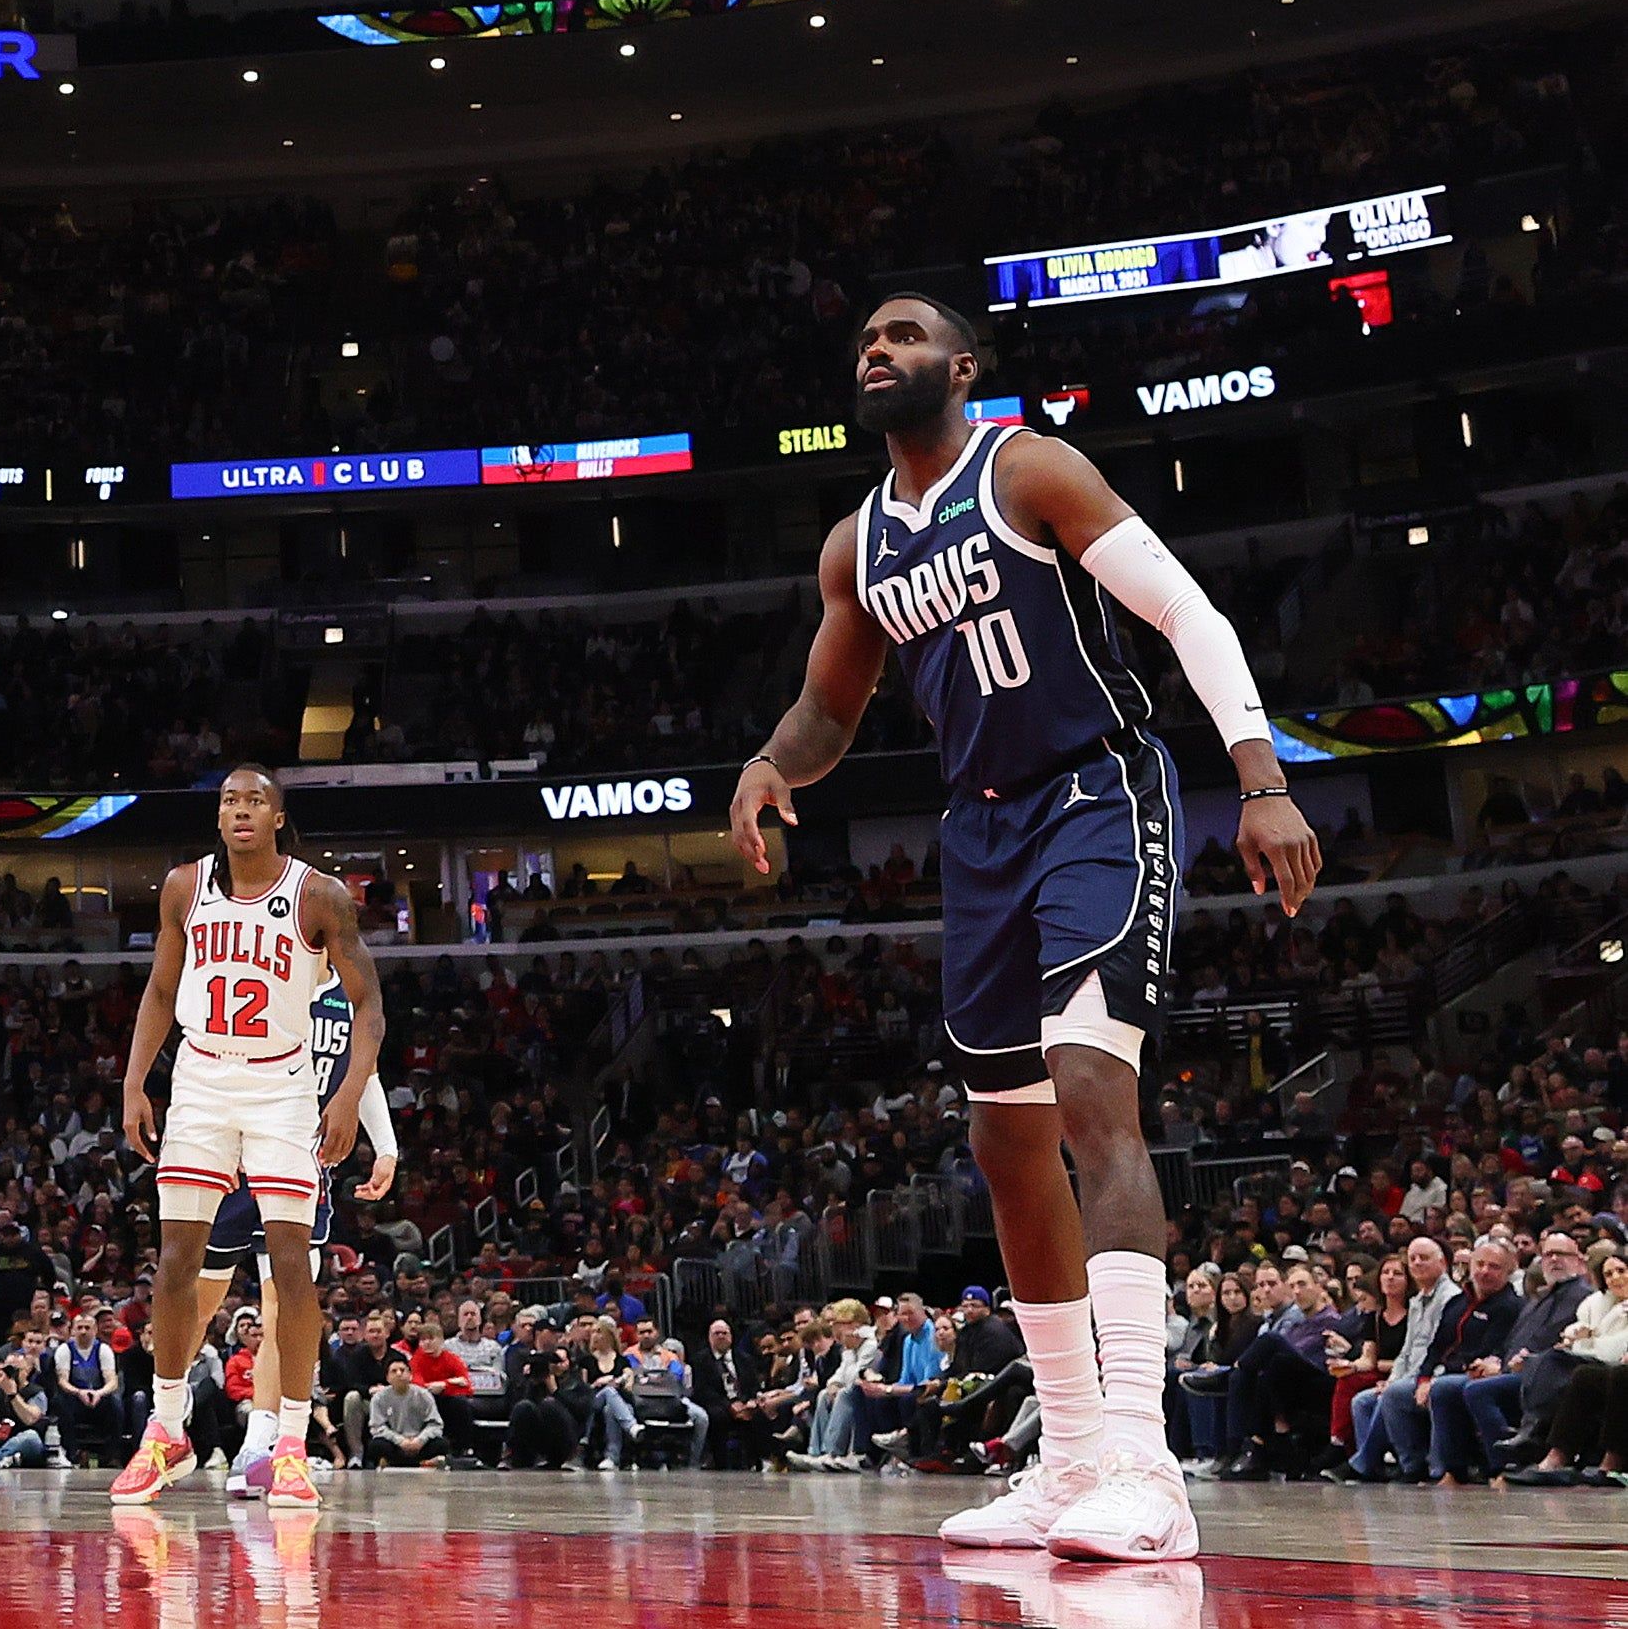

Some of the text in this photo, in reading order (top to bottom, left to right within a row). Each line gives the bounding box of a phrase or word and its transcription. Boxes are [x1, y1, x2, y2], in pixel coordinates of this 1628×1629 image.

[1349, 195, 1429, 232] OLIVIA
[1047, 246, 1158, 279] OLIVIA RODRIGO
[1060, 273, 1099, 297] MARCH
[1137, 366, 1276, 416] VAMOS
[576, 439, 641, 460] MAVERICKS
[779, 424, 847, 454] STEALS
[222, 458, 425, 488] ULTRA CLUB
[938, 495, 977, 525] chime
[871, 533, 1002, 645] MAVS
[954, 608, 1031, 698] 10
[541, 777, 692, 820] VAMOS
[191, 921, 294, 983] BULLS
[205, 975, 269, 1039] 12
